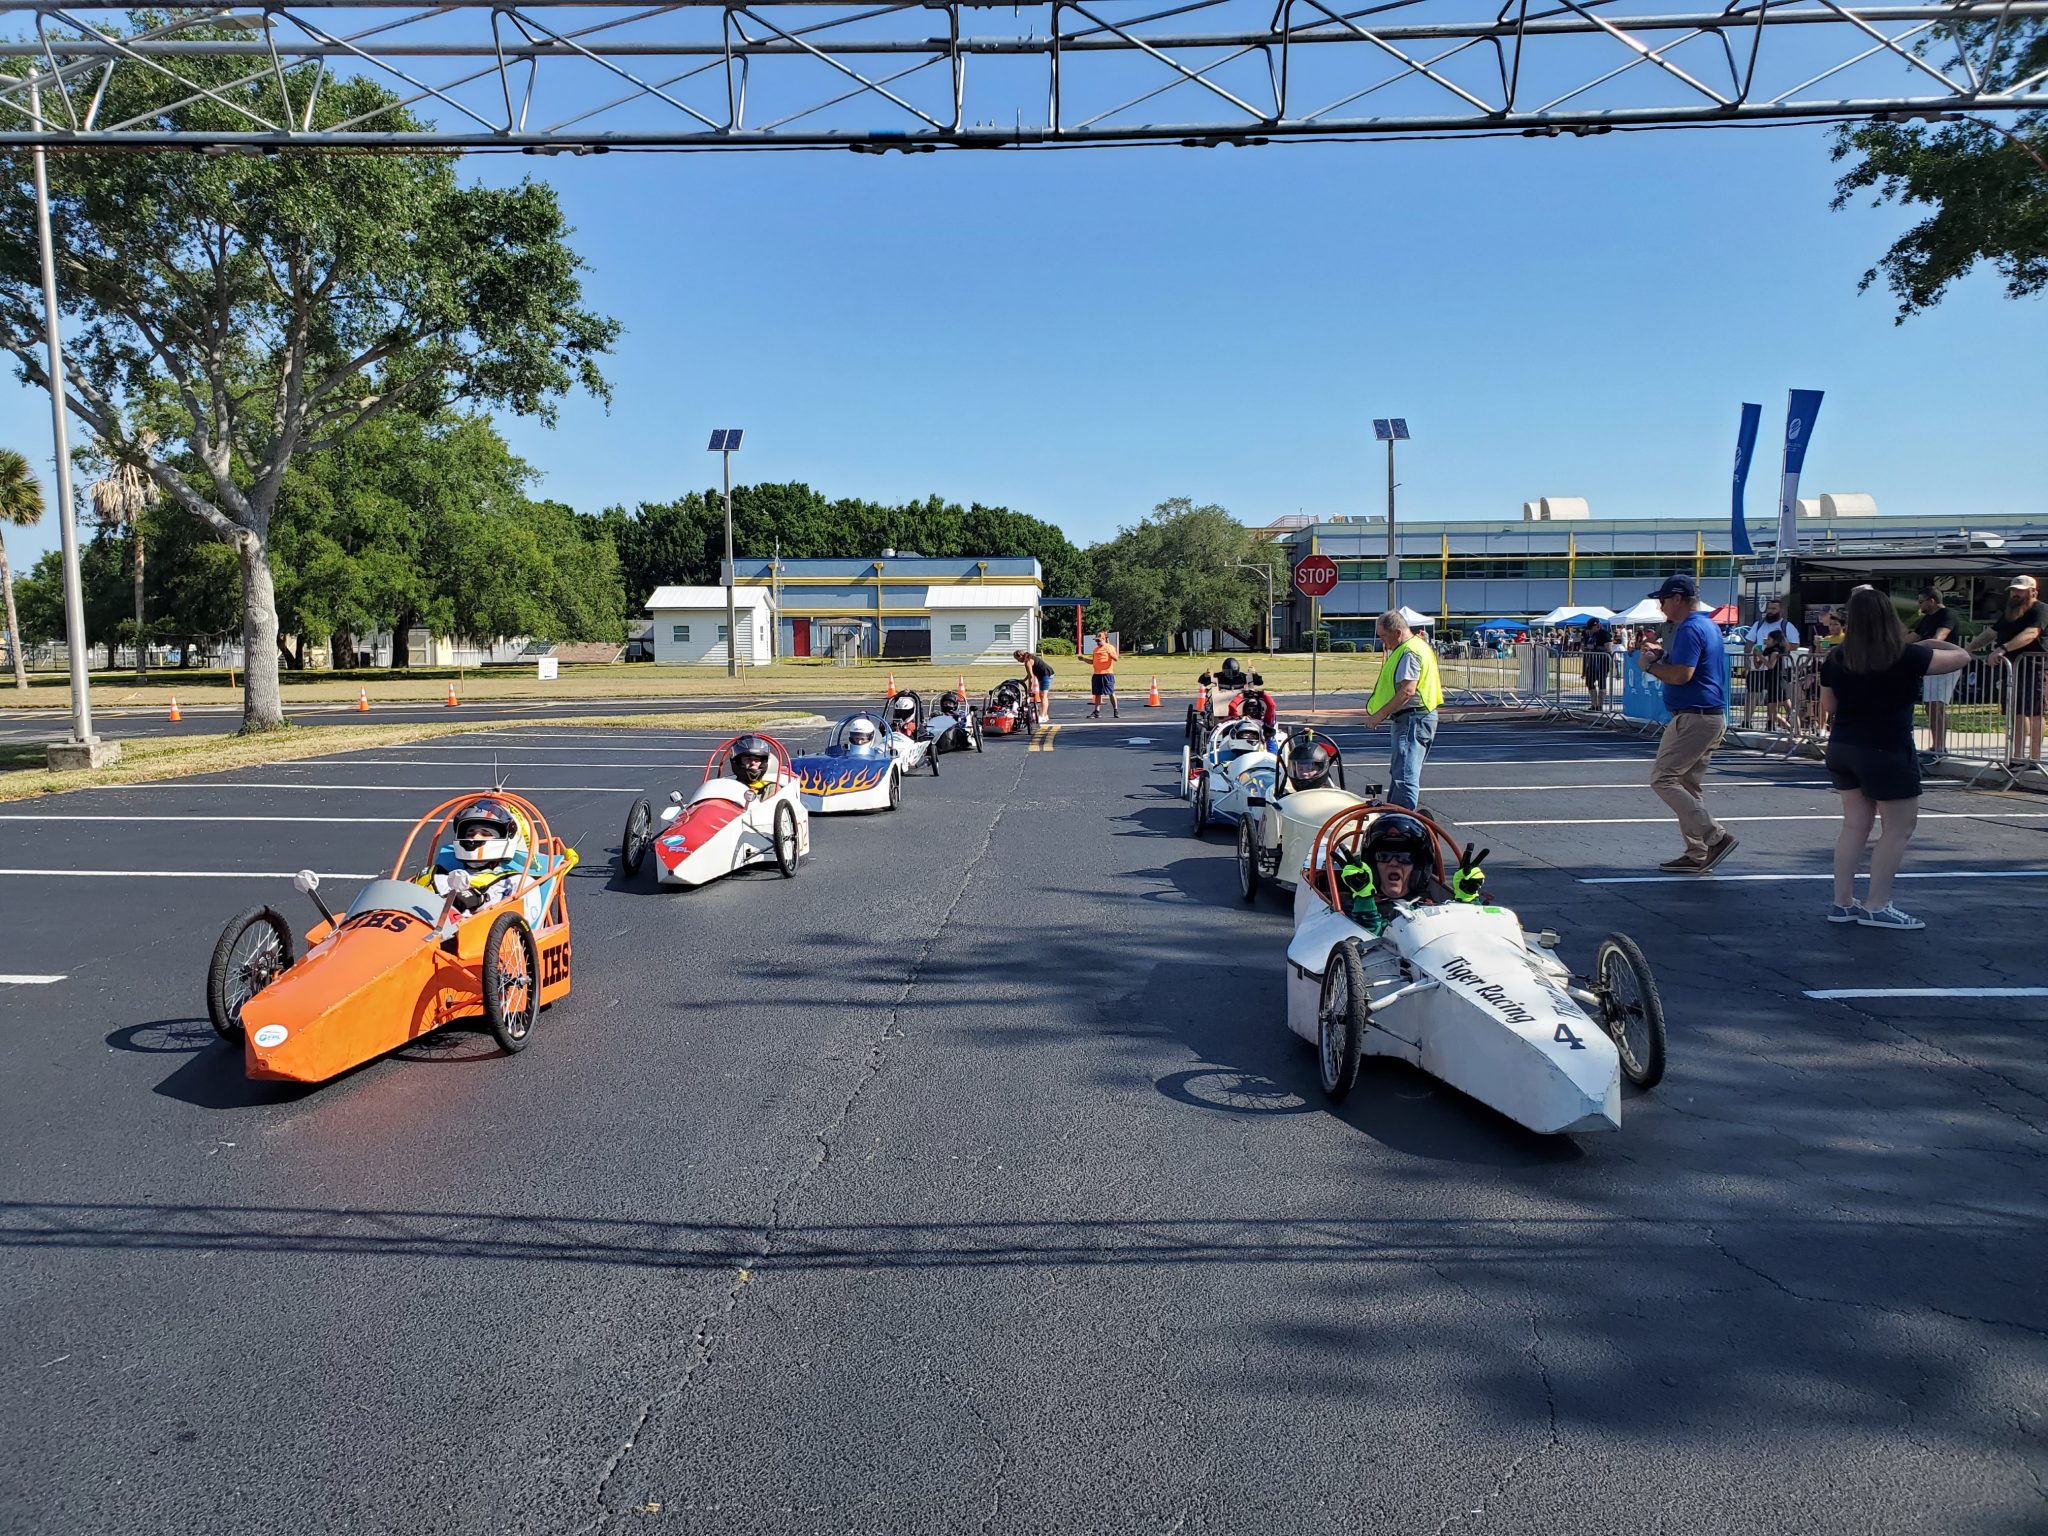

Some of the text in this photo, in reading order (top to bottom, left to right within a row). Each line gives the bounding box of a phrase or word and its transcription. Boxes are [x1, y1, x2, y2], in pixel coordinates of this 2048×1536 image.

[1298, 568, 1336, 583] STOP
[542, 942, 569, 988] IHS
[1441, 955, 1486, 986] Tiger
[1474, 984, 1537, 1024] Racing
[1553, 1023, 1587, 1050] 4
